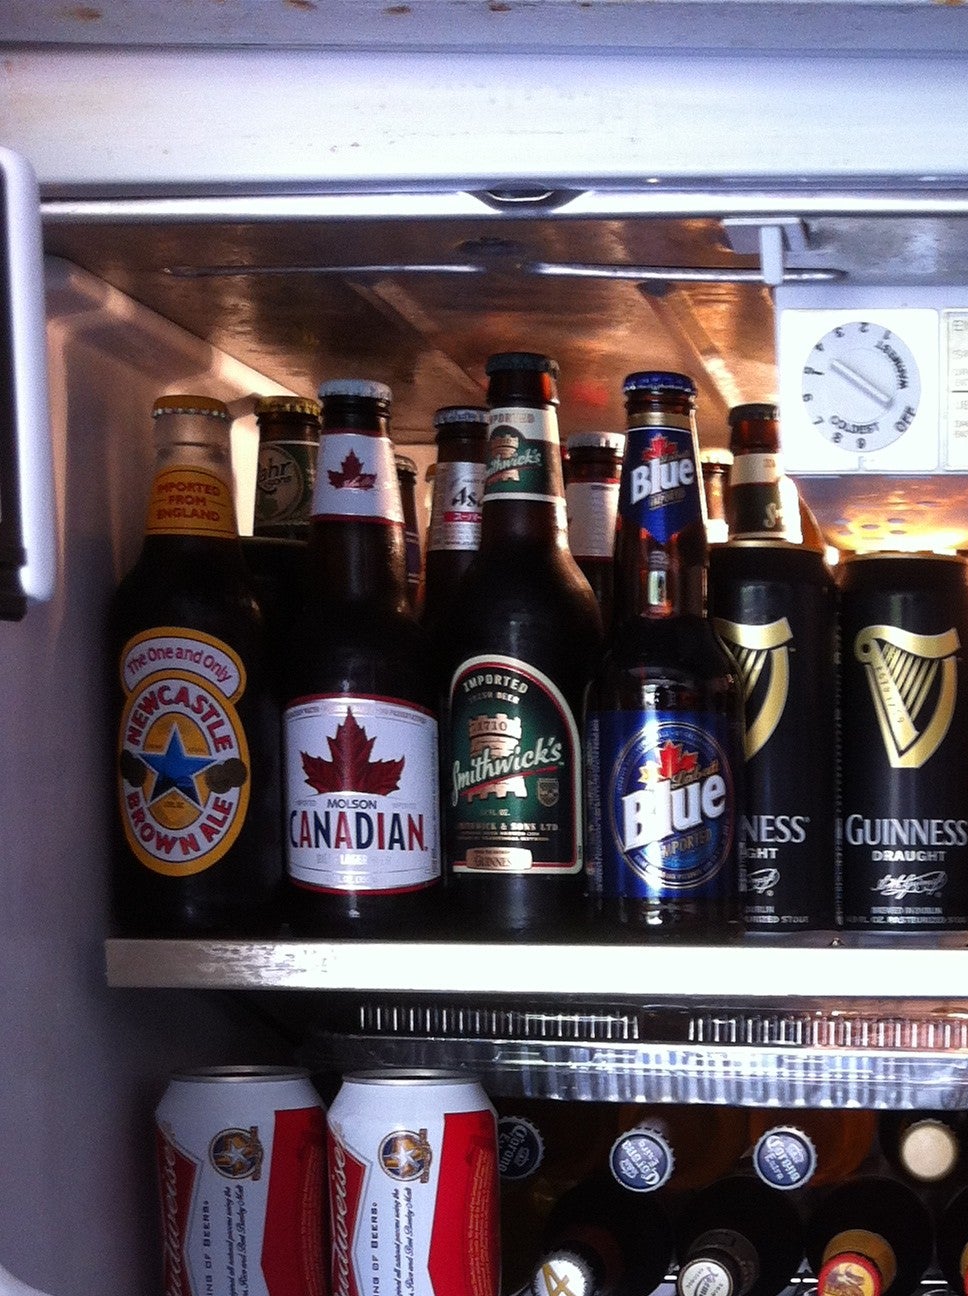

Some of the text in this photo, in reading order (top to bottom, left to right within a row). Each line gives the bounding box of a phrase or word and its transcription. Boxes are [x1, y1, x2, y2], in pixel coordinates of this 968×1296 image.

[860, 322, 869, 333] 2
[874, 341, 908, 390] WARMEST
[830, 415, 879, 434] COLDEST
[895, 406, 916, 432] OFF
[156, 481, 221, 497] IMPORTED
[630, 457, 694, 505] Blue
[156, 507, 220, 522] ENGLAND
[168, 495, 207, 507] FROM
[126, 645, 233, 684] The One and Only
[462, 673, 530, 694] IMPORTED
[126, 684, 235, 752] NEWCASTLE
[451, 736, 563, 808] Smithwick's
[326, 798, 378, 811] MOLSON
[622, 773, 727, 852] Blue
[126, 790, 234, 857] BROWN ALE
[741, 815, 806, 844] NESS
[871, 850, 947, 862] DRAUGHT
[621, 1139, 661, 1187] Corona
[763, 1153, 785, 1182] Extra
[765, 1135, 800, 1183] Corona
[390, 1188, 398, 1199] the
[203, 1206, 211, 1247] BEERS
[370, 1208, 379, 1248] BEERS
[204, 1253, 212, 1268] OF
[372, 1255, 379, 1271] OF
